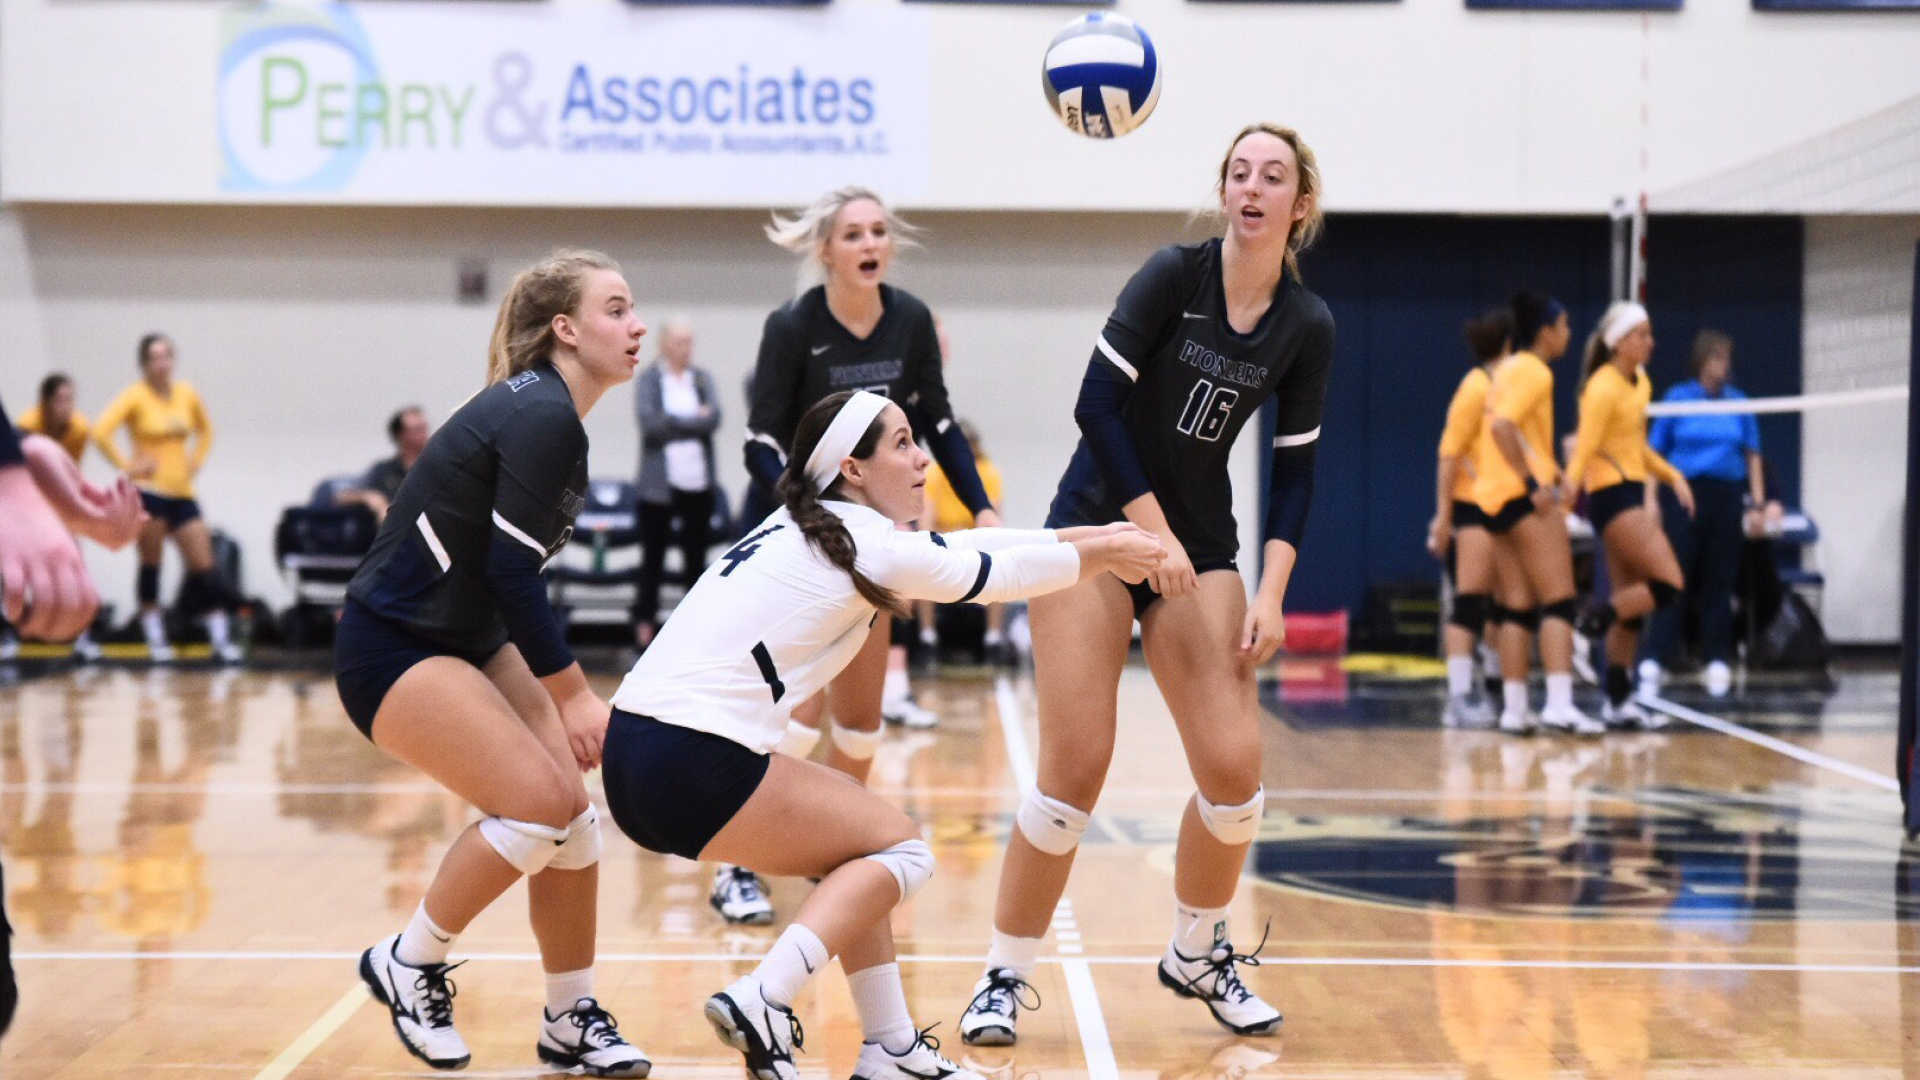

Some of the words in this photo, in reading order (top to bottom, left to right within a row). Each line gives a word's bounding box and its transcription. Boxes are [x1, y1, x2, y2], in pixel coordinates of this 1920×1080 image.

[482, 50, 550, 150] &
[560, 63, 875, 125] Associates
[1180, 340, 1269, 389] PIONEERS
[1177, 378, 1239, 442] 16
